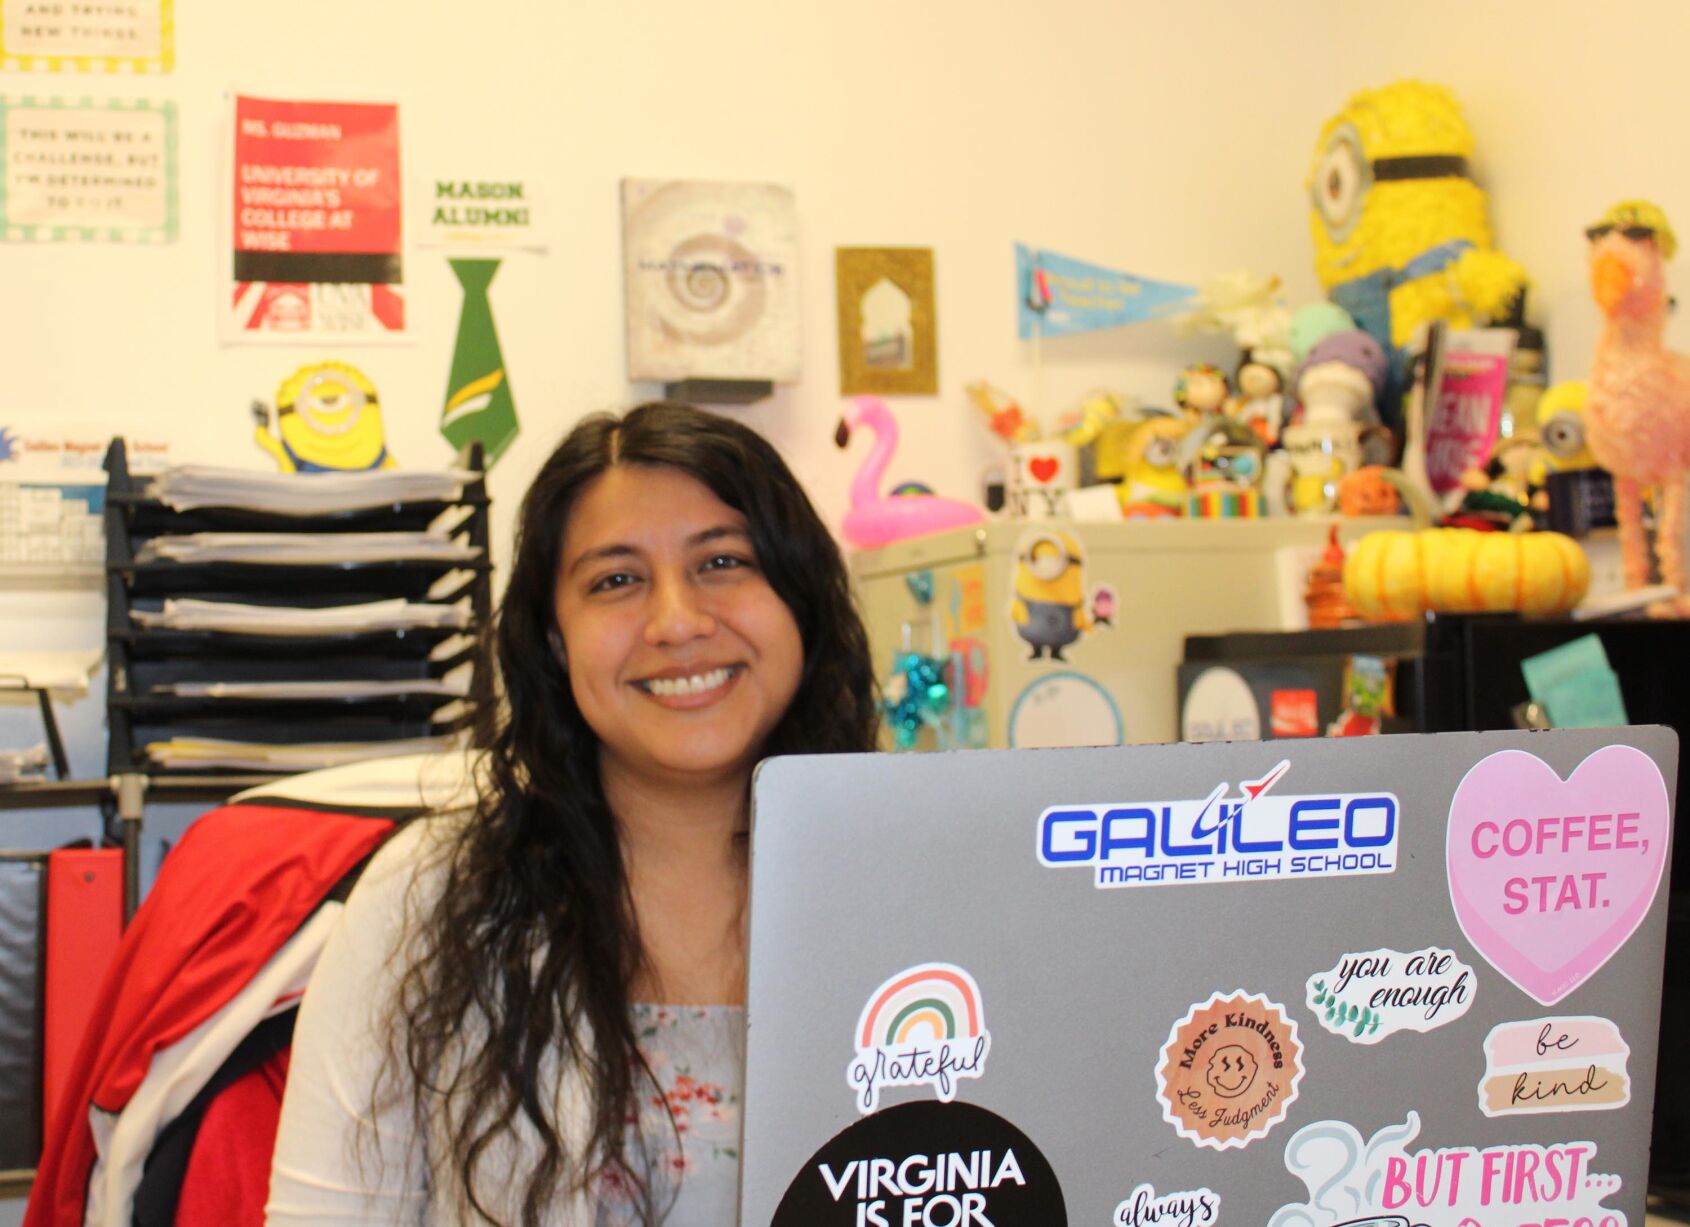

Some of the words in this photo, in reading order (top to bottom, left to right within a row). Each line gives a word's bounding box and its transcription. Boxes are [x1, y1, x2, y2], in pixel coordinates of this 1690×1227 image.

[271, 120, 342, 141] GUZMAN
[47, 174, 157, 188] DETERMINED
[240, 164, 350, 187] UNIVERSITY
[352, 168, 381, 188] OF
[435, 181, 524, 199] MASON
[240, 186, 342, 208] VIRGINIA'S
[240, 208, 327, 231] COLLEGE
[329, 209, 354, 231] AT
[431, 207, 530, 225] ALUMNI
[240, 230, 293, 252] WISE
[1042, 797, 1396, 862] GALILEO
[1471, 813, 1649, 859] COFFEE,
[1100, 862, 1214, 884] MAGNET
[1223, 857, 1281, 877] HIGH
[1290, 853, 1392, 873] SCHOOL
[1503, 872, 1610, 915] STAT.
[1334, 957, 1393, 993] you
[1405, 952, 1452, 976] are
[1369, 971, 1469, 1020] enough
[1179, 1023, 1219, 1070] More
[1225, 1012, 1284, 1070] Kindness
[1536, 1023, 1580, 1056] be
[854, 1036, 985, 1108] grateful
[1511, 1064, 1608, 1106] kind
[1177, 1086, 1208, 1119] Less
[1209, 1081, 1280, 1129] Judgment
[818, 1148, 1026, 1201] VIRGINIA
[1382, 1152, 1469, 1209] BUT
[1481, 1147, 1614, 1206] FIRST...
[856, 1200, 890, 1227] IS
[903, 1193, 996, 1227] FOR
[1120, 1190, 1215, 1227] always
